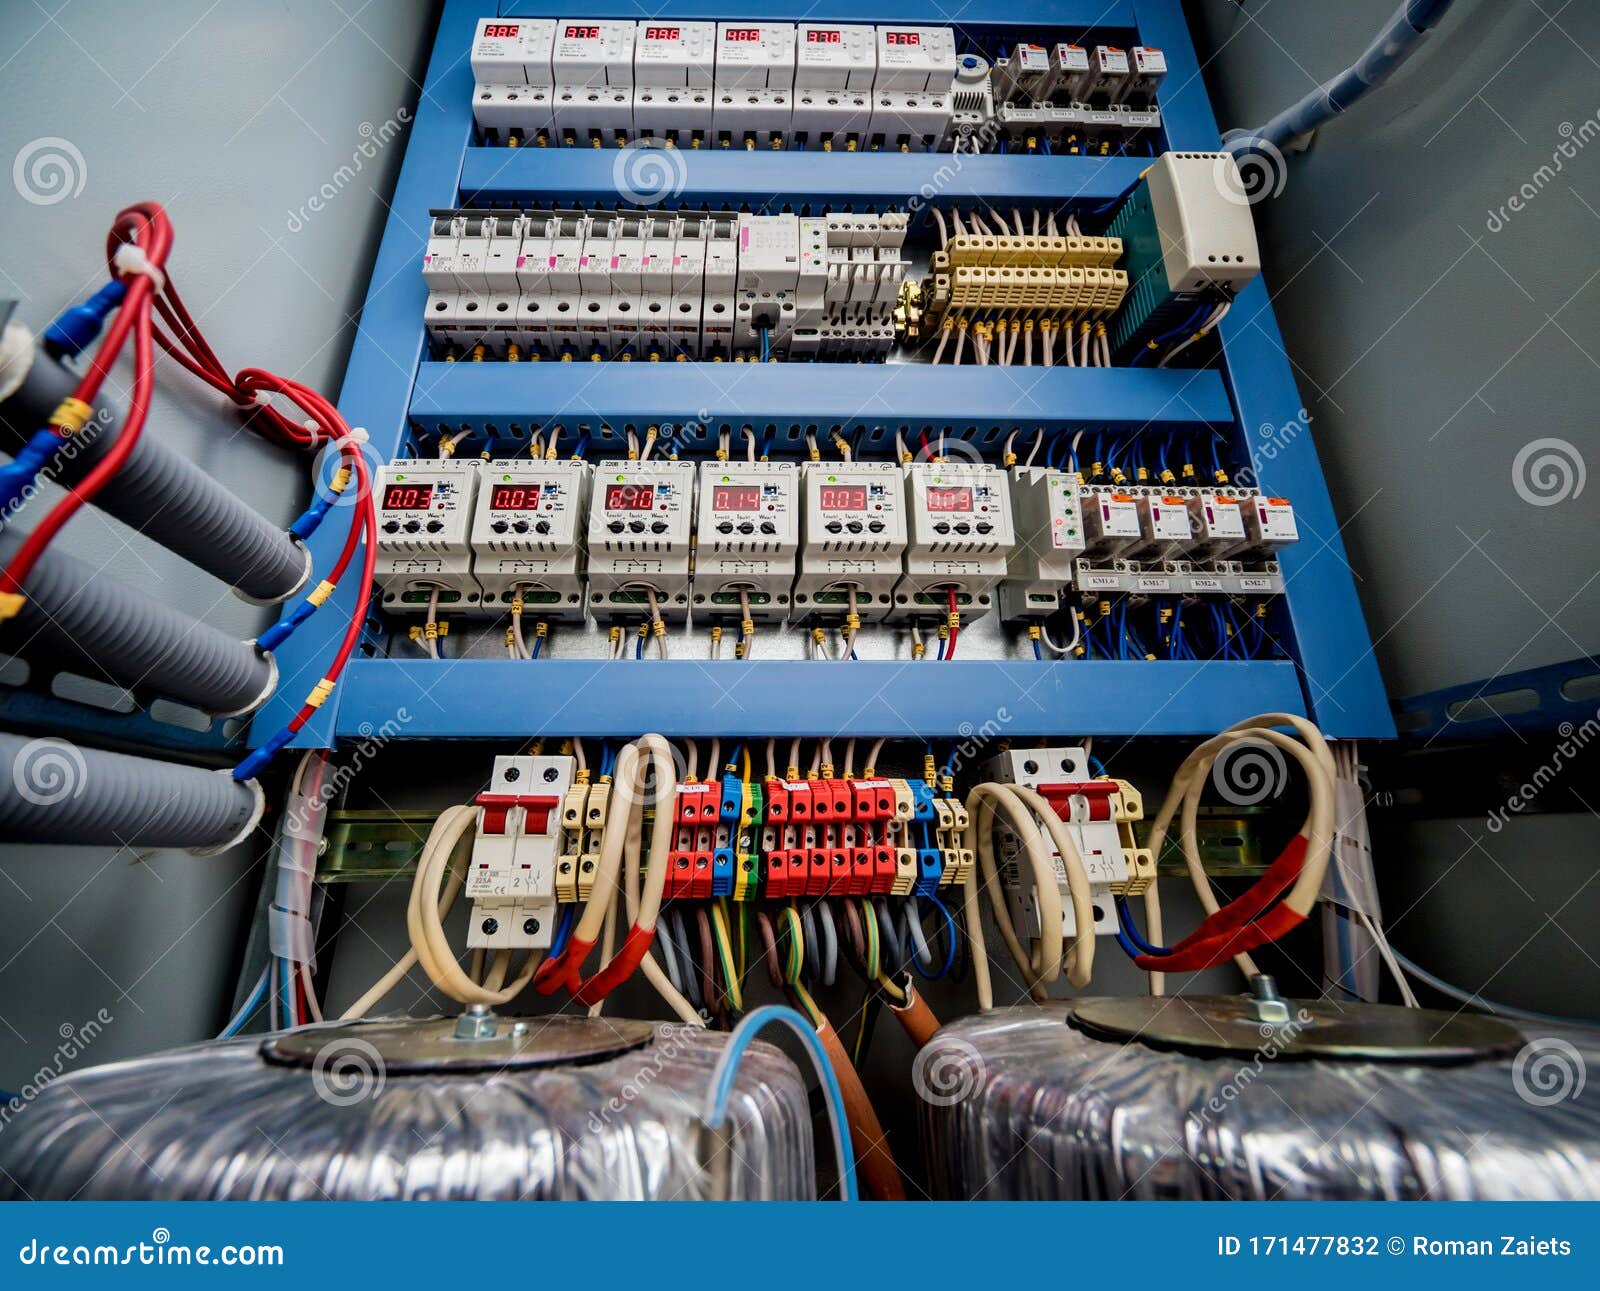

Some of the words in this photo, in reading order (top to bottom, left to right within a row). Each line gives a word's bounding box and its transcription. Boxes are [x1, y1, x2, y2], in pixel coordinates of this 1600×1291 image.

[387, 489, 432, 508] 0.03
[495, 490, 539, 508] 0.03
[609, 490, 653, 508] 0.10
[716, 491, 758, 510] 0.14
[822, 490, 864, 509] 0.03
